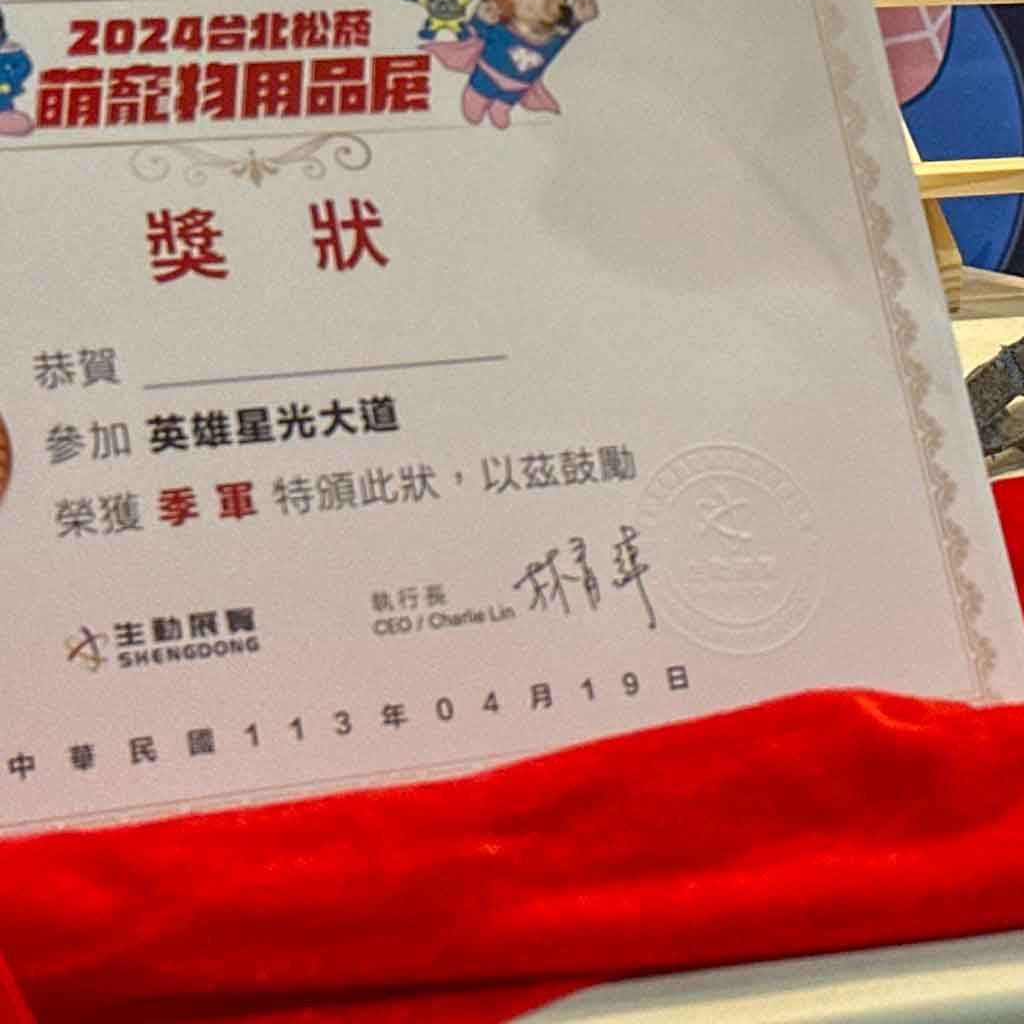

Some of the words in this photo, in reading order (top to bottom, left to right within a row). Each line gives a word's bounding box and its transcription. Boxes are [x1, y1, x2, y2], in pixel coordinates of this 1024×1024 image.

[36, 55, 432, 128] 萌寵物用品展
[33, 347, 122, 390] 恭賀
[45, 421, 133, 465] 參加
[146, 394, 400, 454] 英雄星光大道
[54, 491, 145, 539] 榮獲
[373, 618, 413, 636] CEO
[428, 611, 486, 629] Charlie
[488, 605, 516, 623] Lin
[117, 636, 261, 670] SHENGDONG
